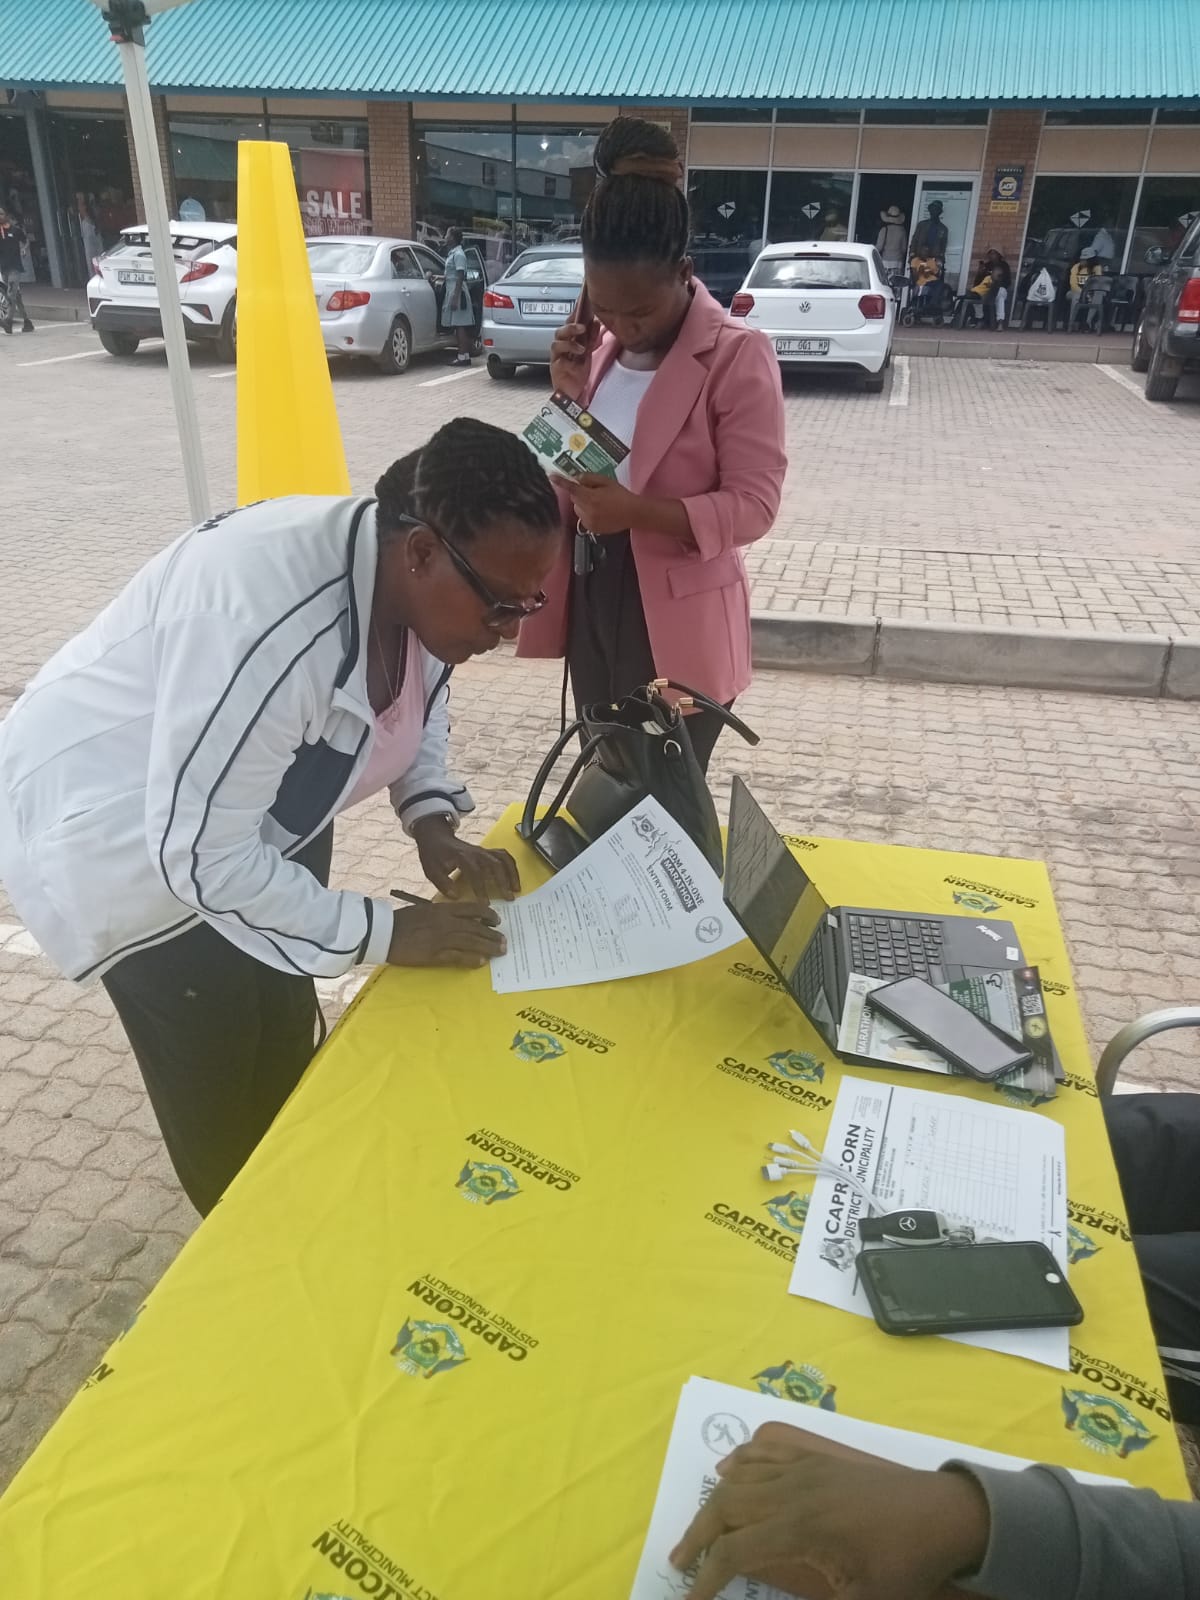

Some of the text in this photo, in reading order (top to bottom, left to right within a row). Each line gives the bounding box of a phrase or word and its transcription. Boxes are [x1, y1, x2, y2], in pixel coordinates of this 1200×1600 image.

[306, 190, 362, 219] SALE
[647, 865, 673, 911] ENTRY FORM
[662, 858, 695, 909] MARATHON
[668, 848, 705, 906] CDM 4-IN-ONE
[943, 877, 1036, 909] CAPRICORN
[515, 1010, 609, 1054] CAPRICORN
[856, 1005, 873, 1055] MARATHON
[716, 1063, 758, 1085] DISTRICT
[759, 1082, 825, 1112] MUNICIPALITY
[723, 1056, 833, 1107] CAPRICORN
[465, 1133, 572, 1191] CAPRICORN
[478, 1127, 581, 1183] DISTRICT MUNICIPALITY
[825, 1124, 861, 1235] CAPRORN
[844, 1192, 864, 1238] DISTRICT
[856, 1126, 876, 1183] UNICIPALITY
[704, 1212, 754, 1241] DISTRICT
[406, 1281, 528, 1361] CAPRICORN
[421, 1273, 540, 1349] DISTRICT MUNICIPALITY
[1070, 1344, 1148, 1389] MUNICIPAL
[332, 1518, 415, 1588] MUNICIPALITY
